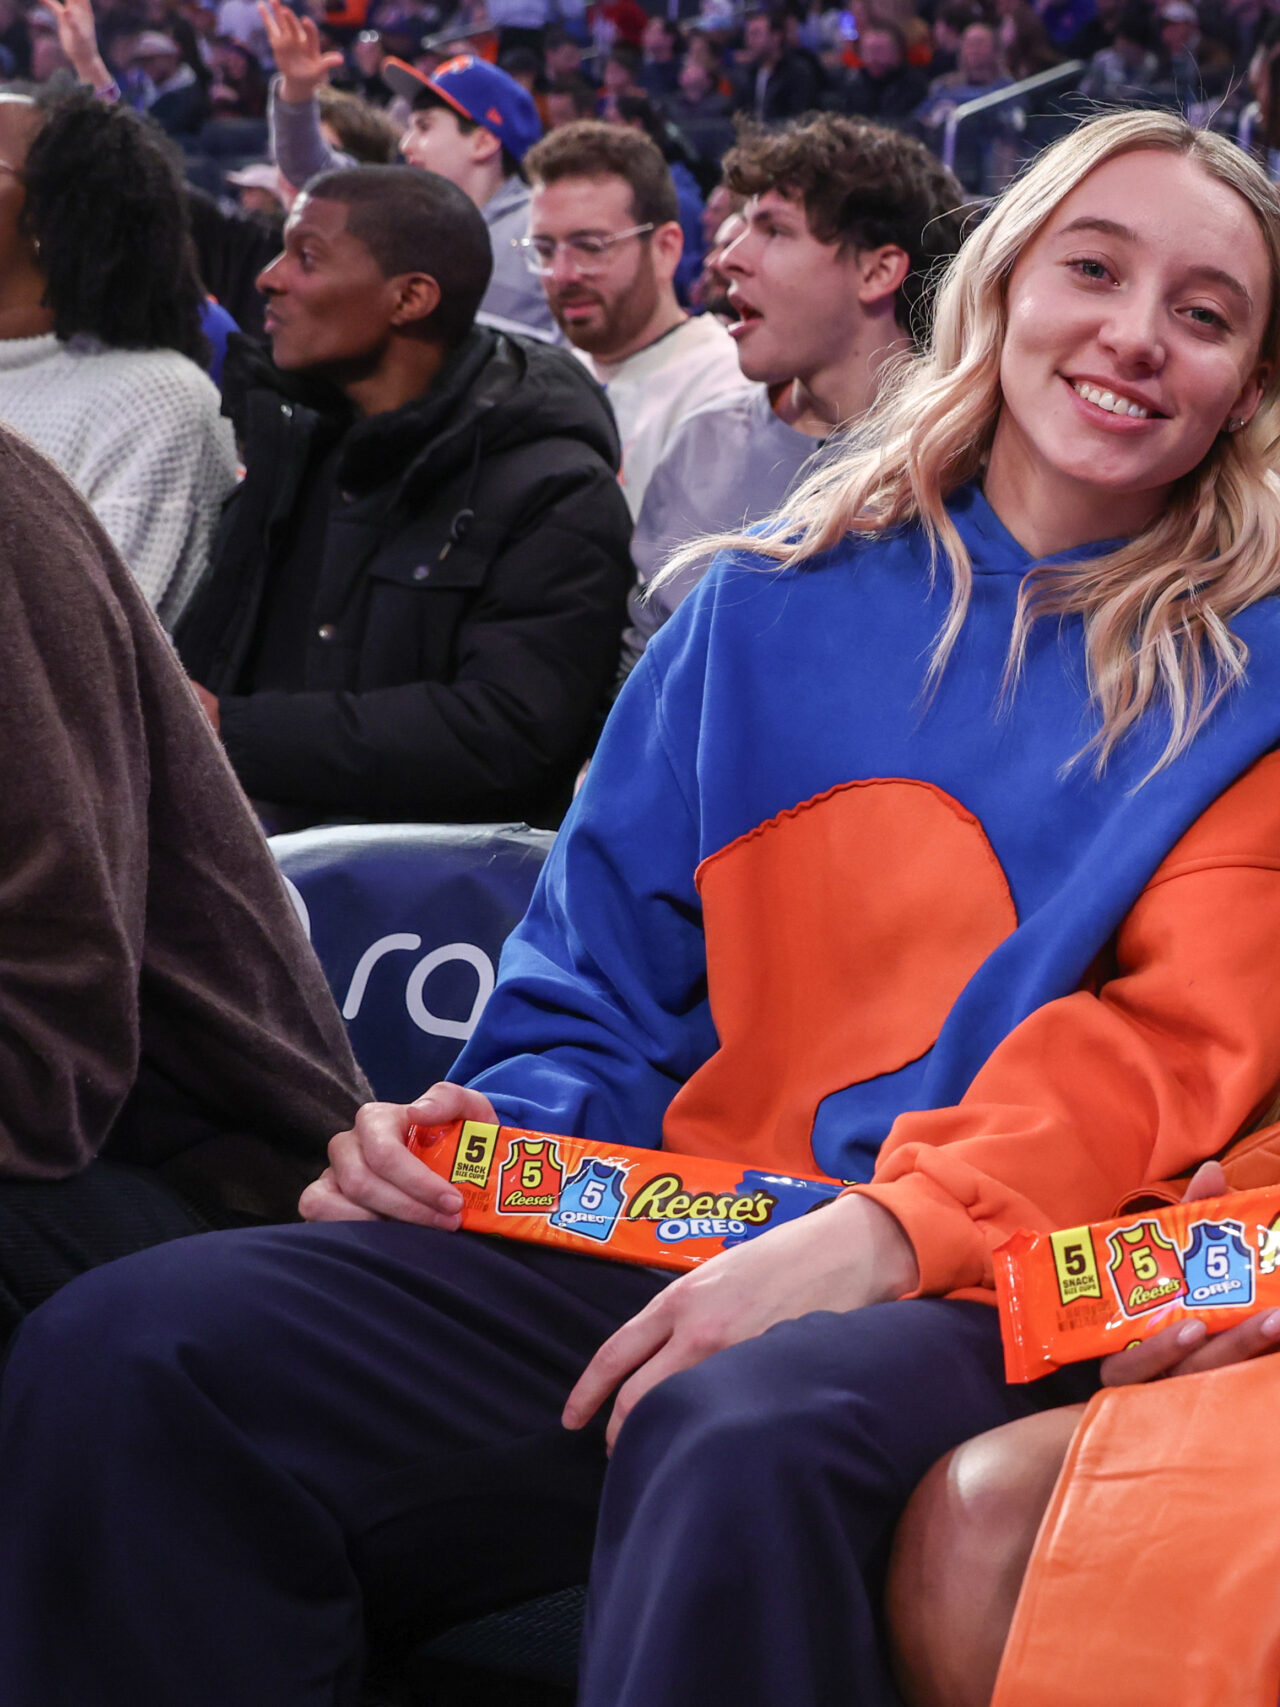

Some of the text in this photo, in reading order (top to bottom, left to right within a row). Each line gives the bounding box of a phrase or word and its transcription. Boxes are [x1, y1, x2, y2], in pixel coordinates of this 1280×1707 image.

[465, 1135, 487, 1163] 5
[455, 1170, 468, 1178] SIZE
[456, 1162, 486, 1175] SNACK
[521, 1160, 543, 1189] 5
[503, 1190, 554, 1206] Reese's
[581, 1179, 608, 1210] 5
[628, 1175, 775, 1224] Reese's
[559, 1211, 605, 1225] OREO
[658, 1219, 745, 1241] OREO
[1063, 1244, 1087, 1276] 5
[1131, 1246, 1159, 1281] 5
[1206, 1245, 1229, 1278] 5
[1062, 1275, 1096, 1289] SNACK
[1063, 1283, 1097, 1296] SIZE CUPS
[1128, 1278, 1181, 1308] Reese's
[1193, 1280, 1242, 1300] OREO
